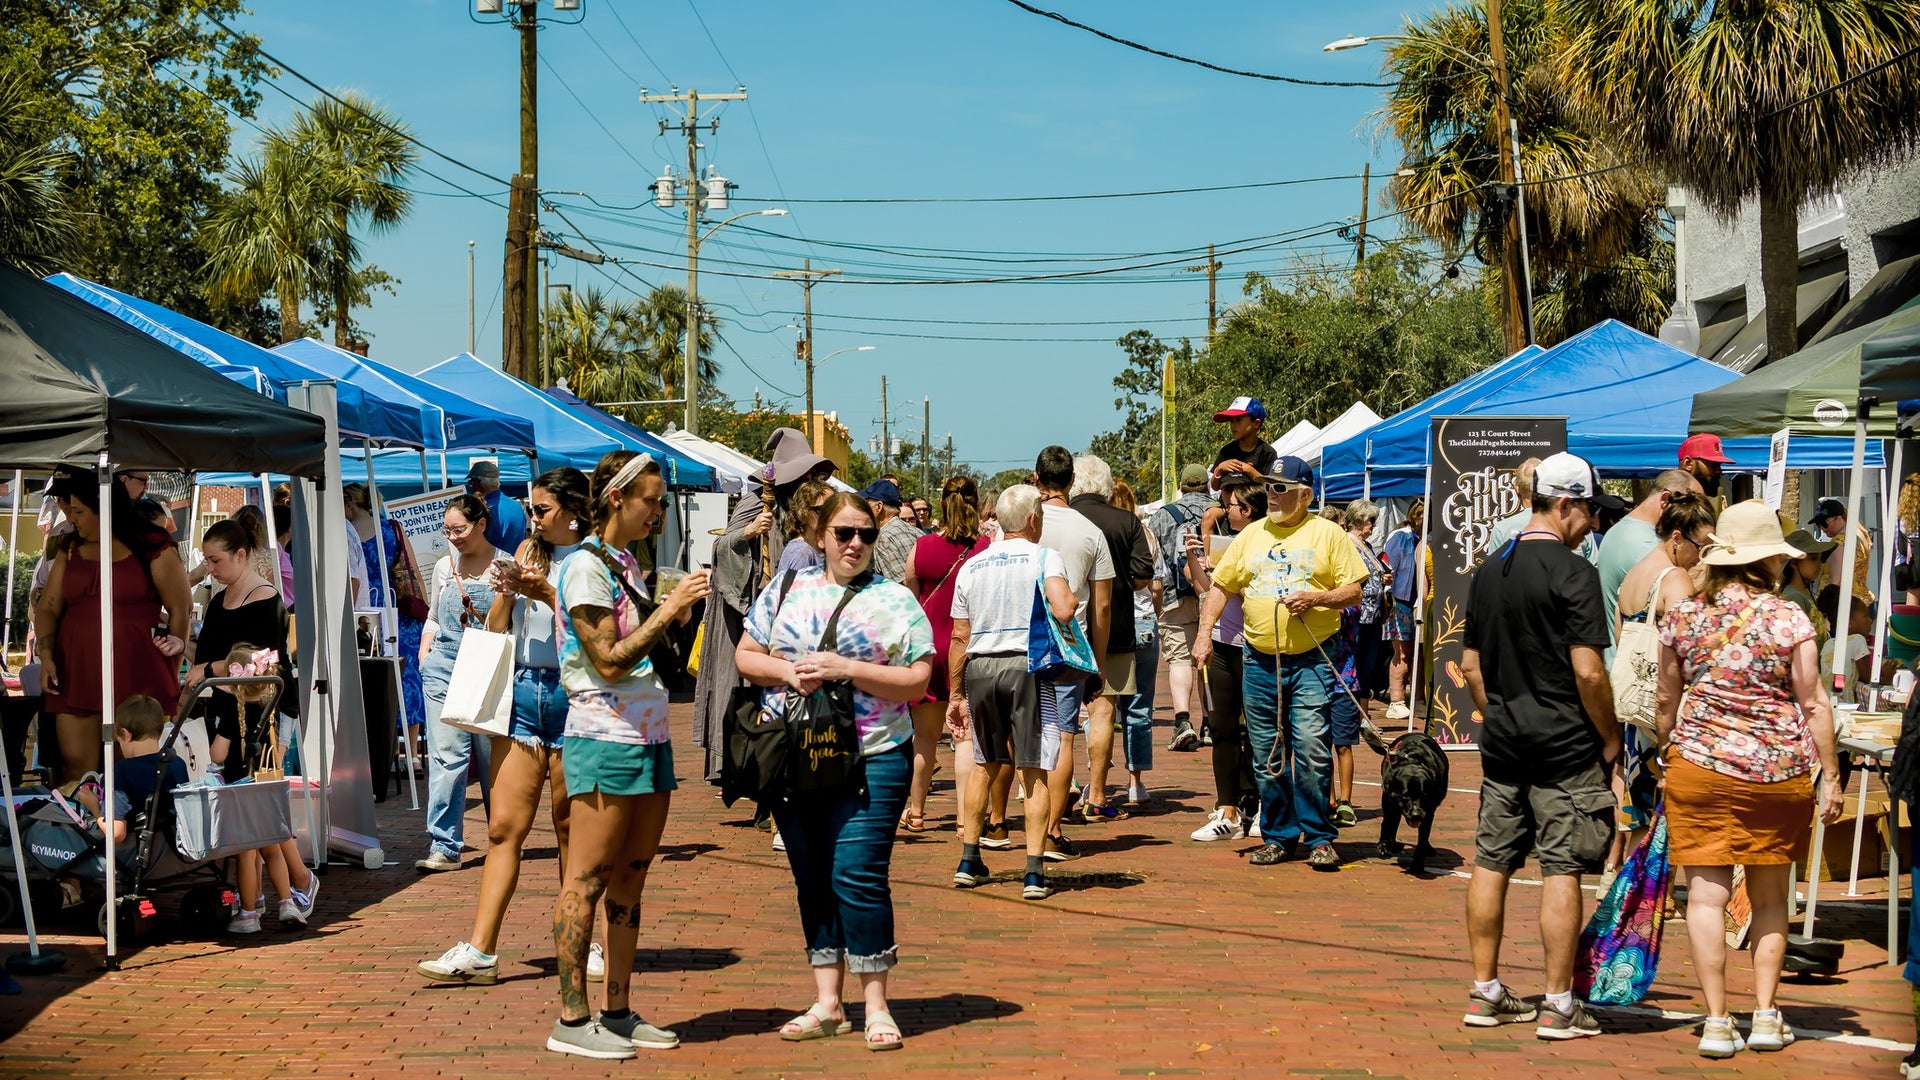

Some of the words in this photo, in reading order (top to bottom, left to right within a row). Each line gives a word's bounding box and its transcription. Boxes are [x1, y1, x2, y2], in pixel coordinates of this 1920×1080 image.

[1448, 440, 1551, 448] TheGildedPageBookstore.com
[1457, 466, 1513, 504] The
[389, 508, 407, 520] TOP
[408, 504, 426, 516] TEN
[426, 499, 452, 512] REAS
[1442, 488, 1522, 534] GILD
[404, 518, 422, 528] JOIN
[422, 513, 438, 523] THE
[405, 529, 415, 538] OF
[415, 525, 431, 535] THE
[810, 747, 852, 772] you
